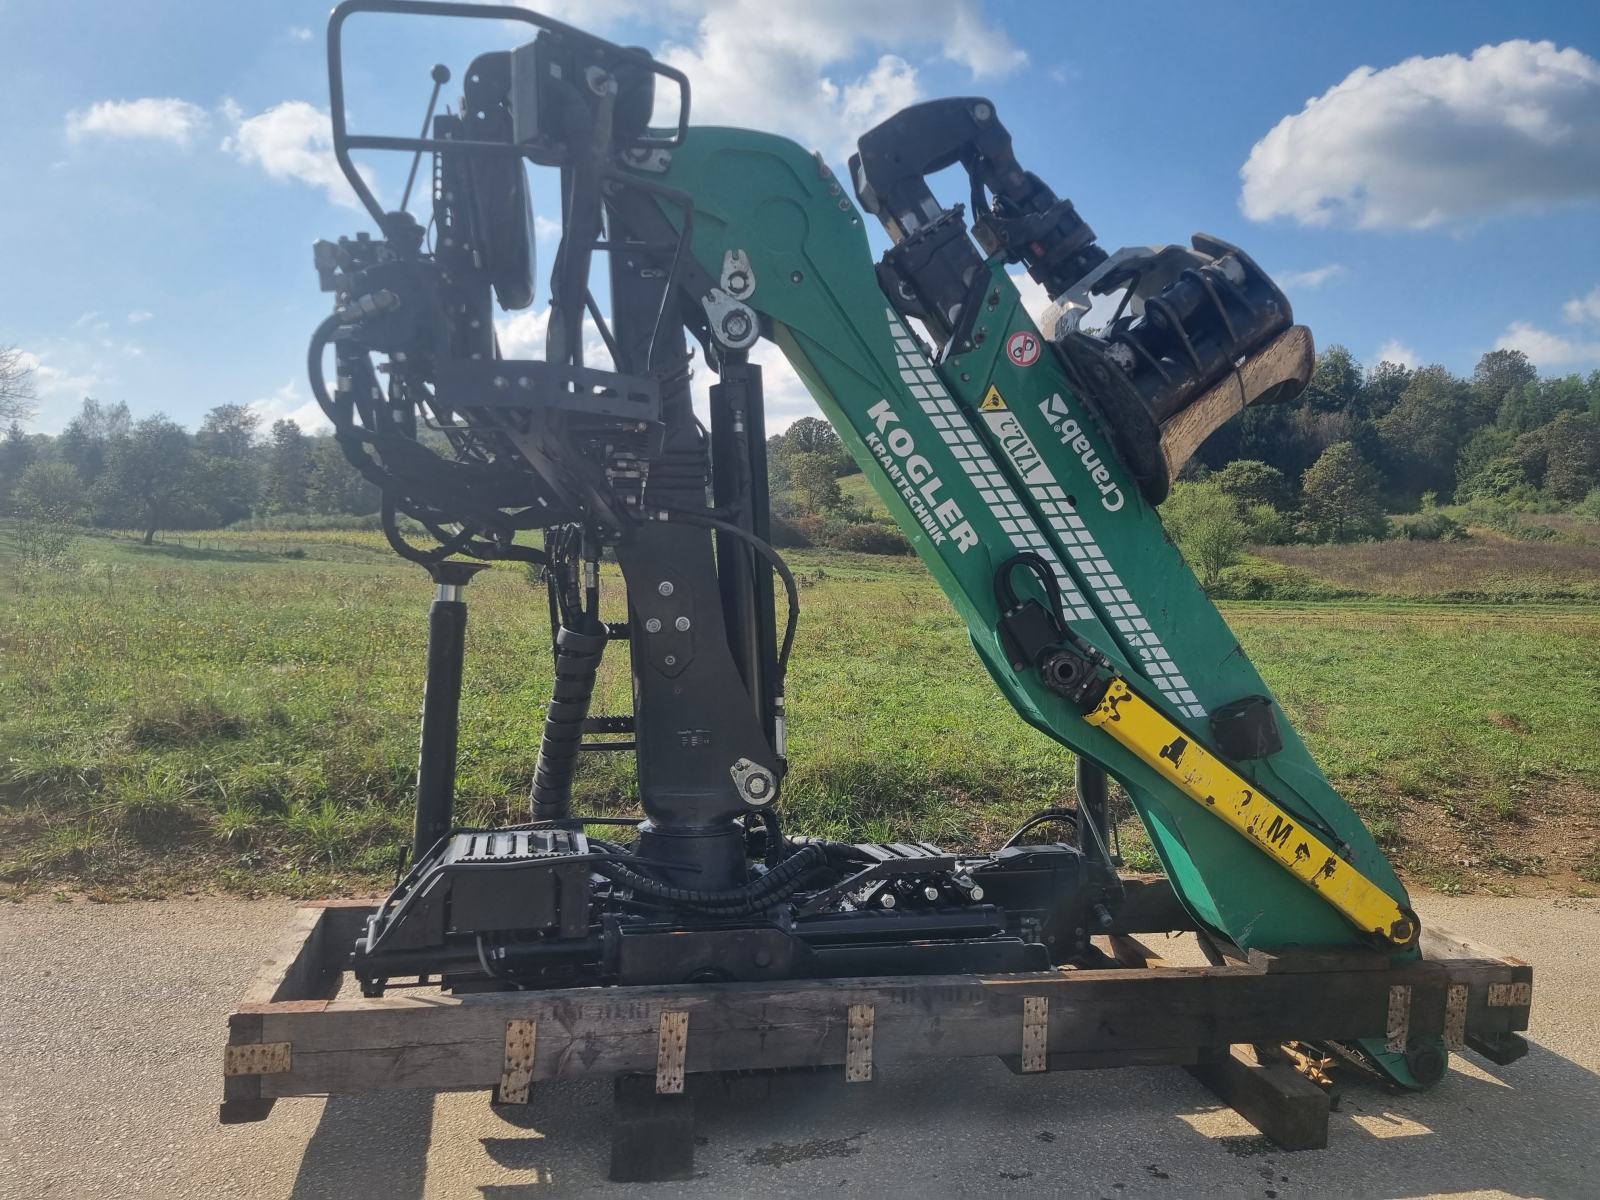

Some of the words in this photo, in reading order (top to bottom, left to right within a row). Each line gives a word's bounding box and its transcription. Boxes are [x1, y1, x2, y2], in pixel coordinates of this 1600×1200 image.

[865, 432, 947, 546] KRANTECHNIK
[867, 399, 979, 554] KOGLER
[1001, 417, 1042, 479] TZ12.2
[1060, 419, 1125, 512] Cranab
